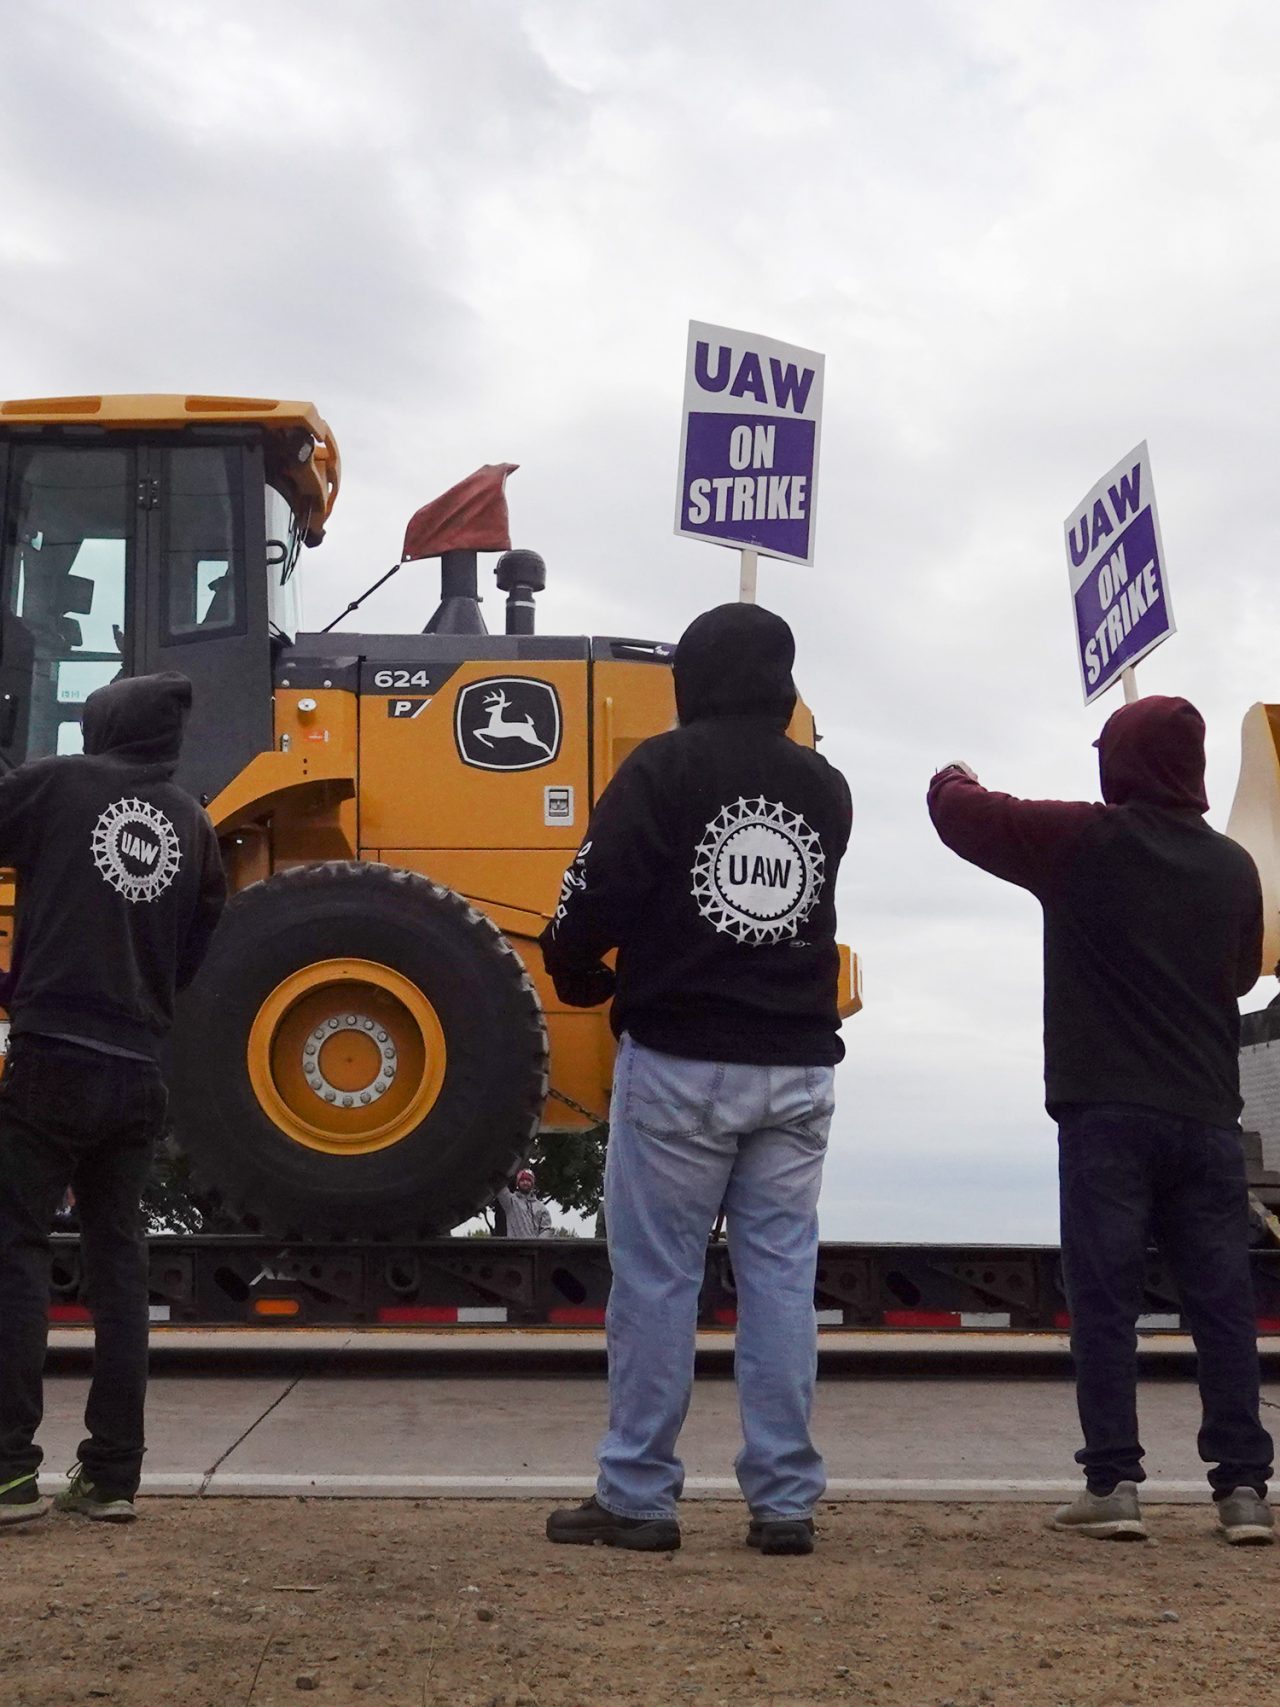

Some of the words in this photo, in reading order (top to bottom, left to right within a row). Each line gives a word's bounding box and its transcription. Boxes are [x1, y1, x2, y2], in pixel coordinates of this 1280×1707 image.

[694, 340, 816, 415] UAW
[729, 424, 776, 471] ON
[688, 475, 807, 525] STRIKE
[1068, 462, 1141, 568] UAW
[1098, 542, 1129, 611] ON
[1084, 558, 1160, 686] STRIKE
[374, 670, 431, 688] 624
[394, 701, 412, 716] P
[121, 831, 160, 866] UAW
[728, 854, 792, 889] UAW
